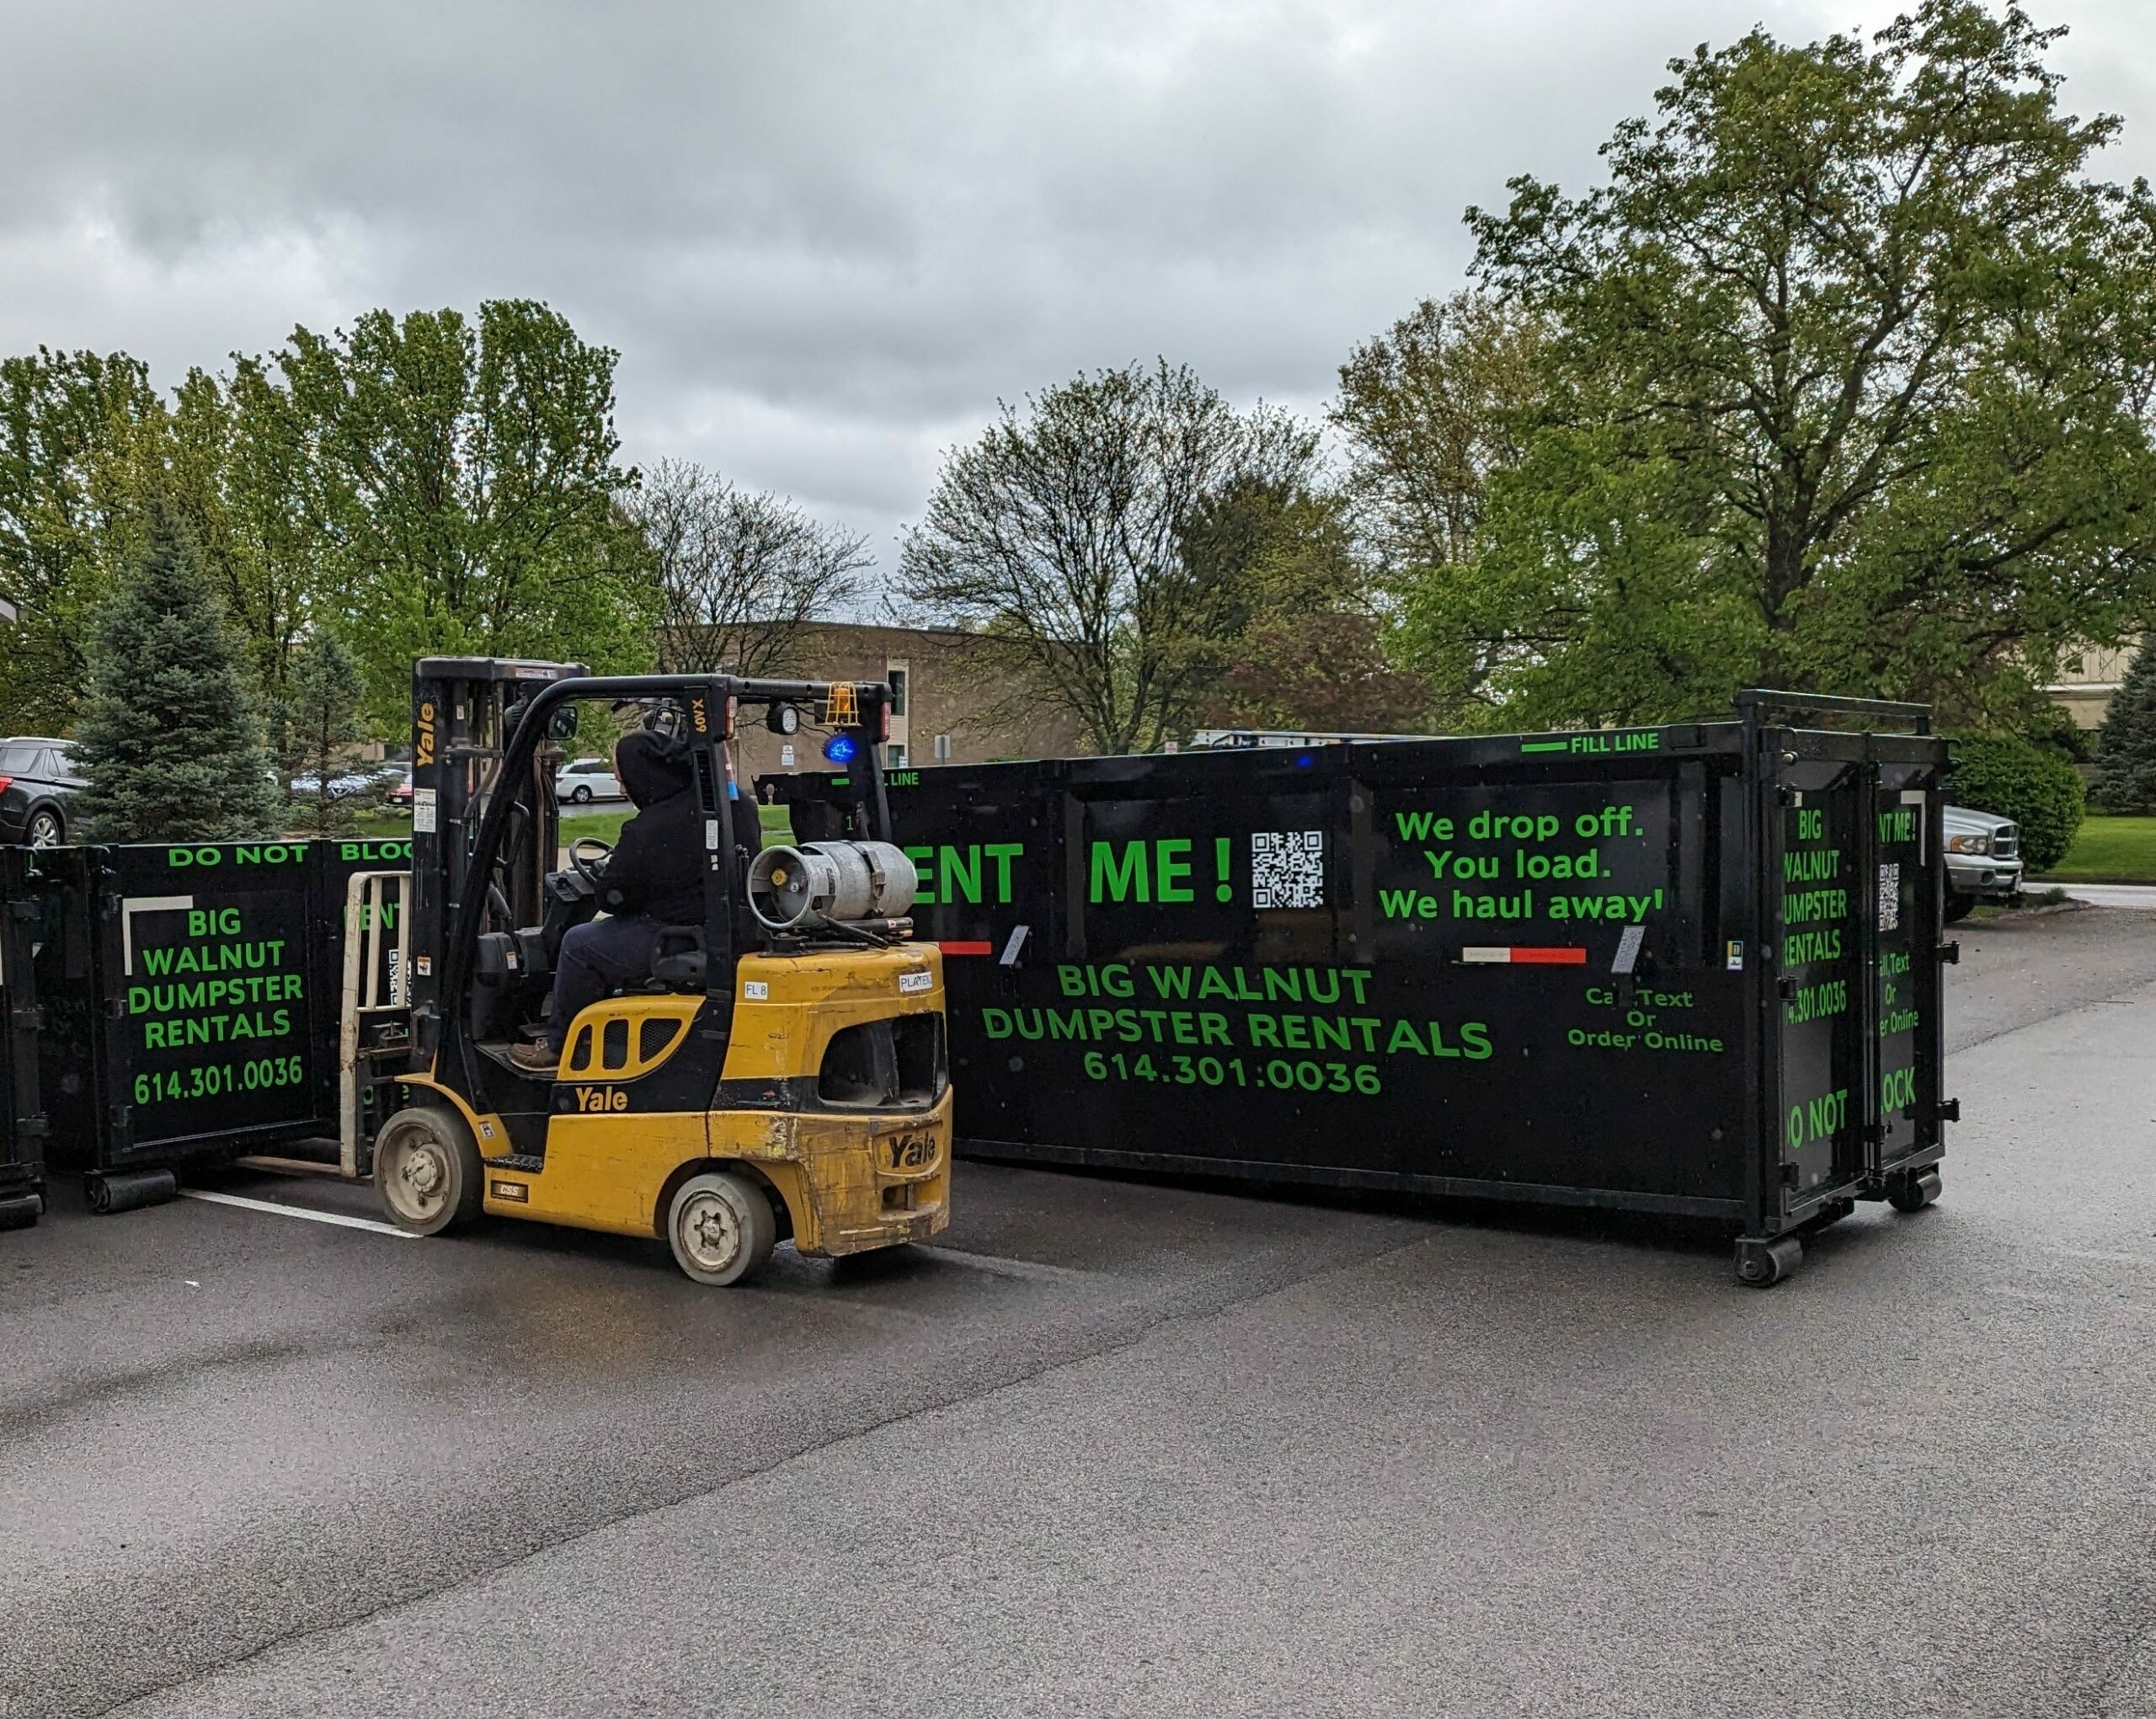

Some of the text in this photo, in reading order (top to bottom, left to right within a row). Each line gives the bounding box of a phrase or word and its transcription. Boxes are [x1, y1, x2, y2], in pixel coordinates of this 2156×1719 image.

[691, 698, 707, 733] 60VX
[417, 702, 435, 767] Yale
[1571, 733, 1659, 754] FILL LINE
[890, 771, 919, 787] LINE
[1395, 805, 1644, 842] We drop off.
[1799, 809, 1822, 840] BIG
[168, 846, 221, 867] DO
[236, 844, 309, 864] NOT
[904, 842, 1024, 905] ENT
[1424, 847, 1611, 879] You load.
[189, 907, 241, 937] BIG
[1379, 889, 1438, 919] We
[1452, 889, 1533, 919] haul
[1784, 889, 1847, 925] UMPSTER
[142, 940, 286, 976] WALNUT
[128, 974, 303, 1016] DUMPSTER
[746, 985, 767, 996] FL 8
[1057, 964, 1373, 1005] BIG WALNUT
[1636, 989, 1694, 1008] Text
[145, 1009, 291, 1049] RENTALS
[982, 1008, 1493, 1060] DUMPSTER RENTALS
[1626, 1010, 1657, 1027] Or
[1568, 1028, 1724, 1053] Order Online
[135, 1055, 302, 1105] 614.301.0036
[1084, 1051, 1381, 1095] 614.301.0036
[1881, 1066, 1916, 1115] OCK
[575, 1086, 628, 1112] Yale
[1809, 1088, 1848, 1142] NOT
[889, 1130, 936, 1167] Yale
